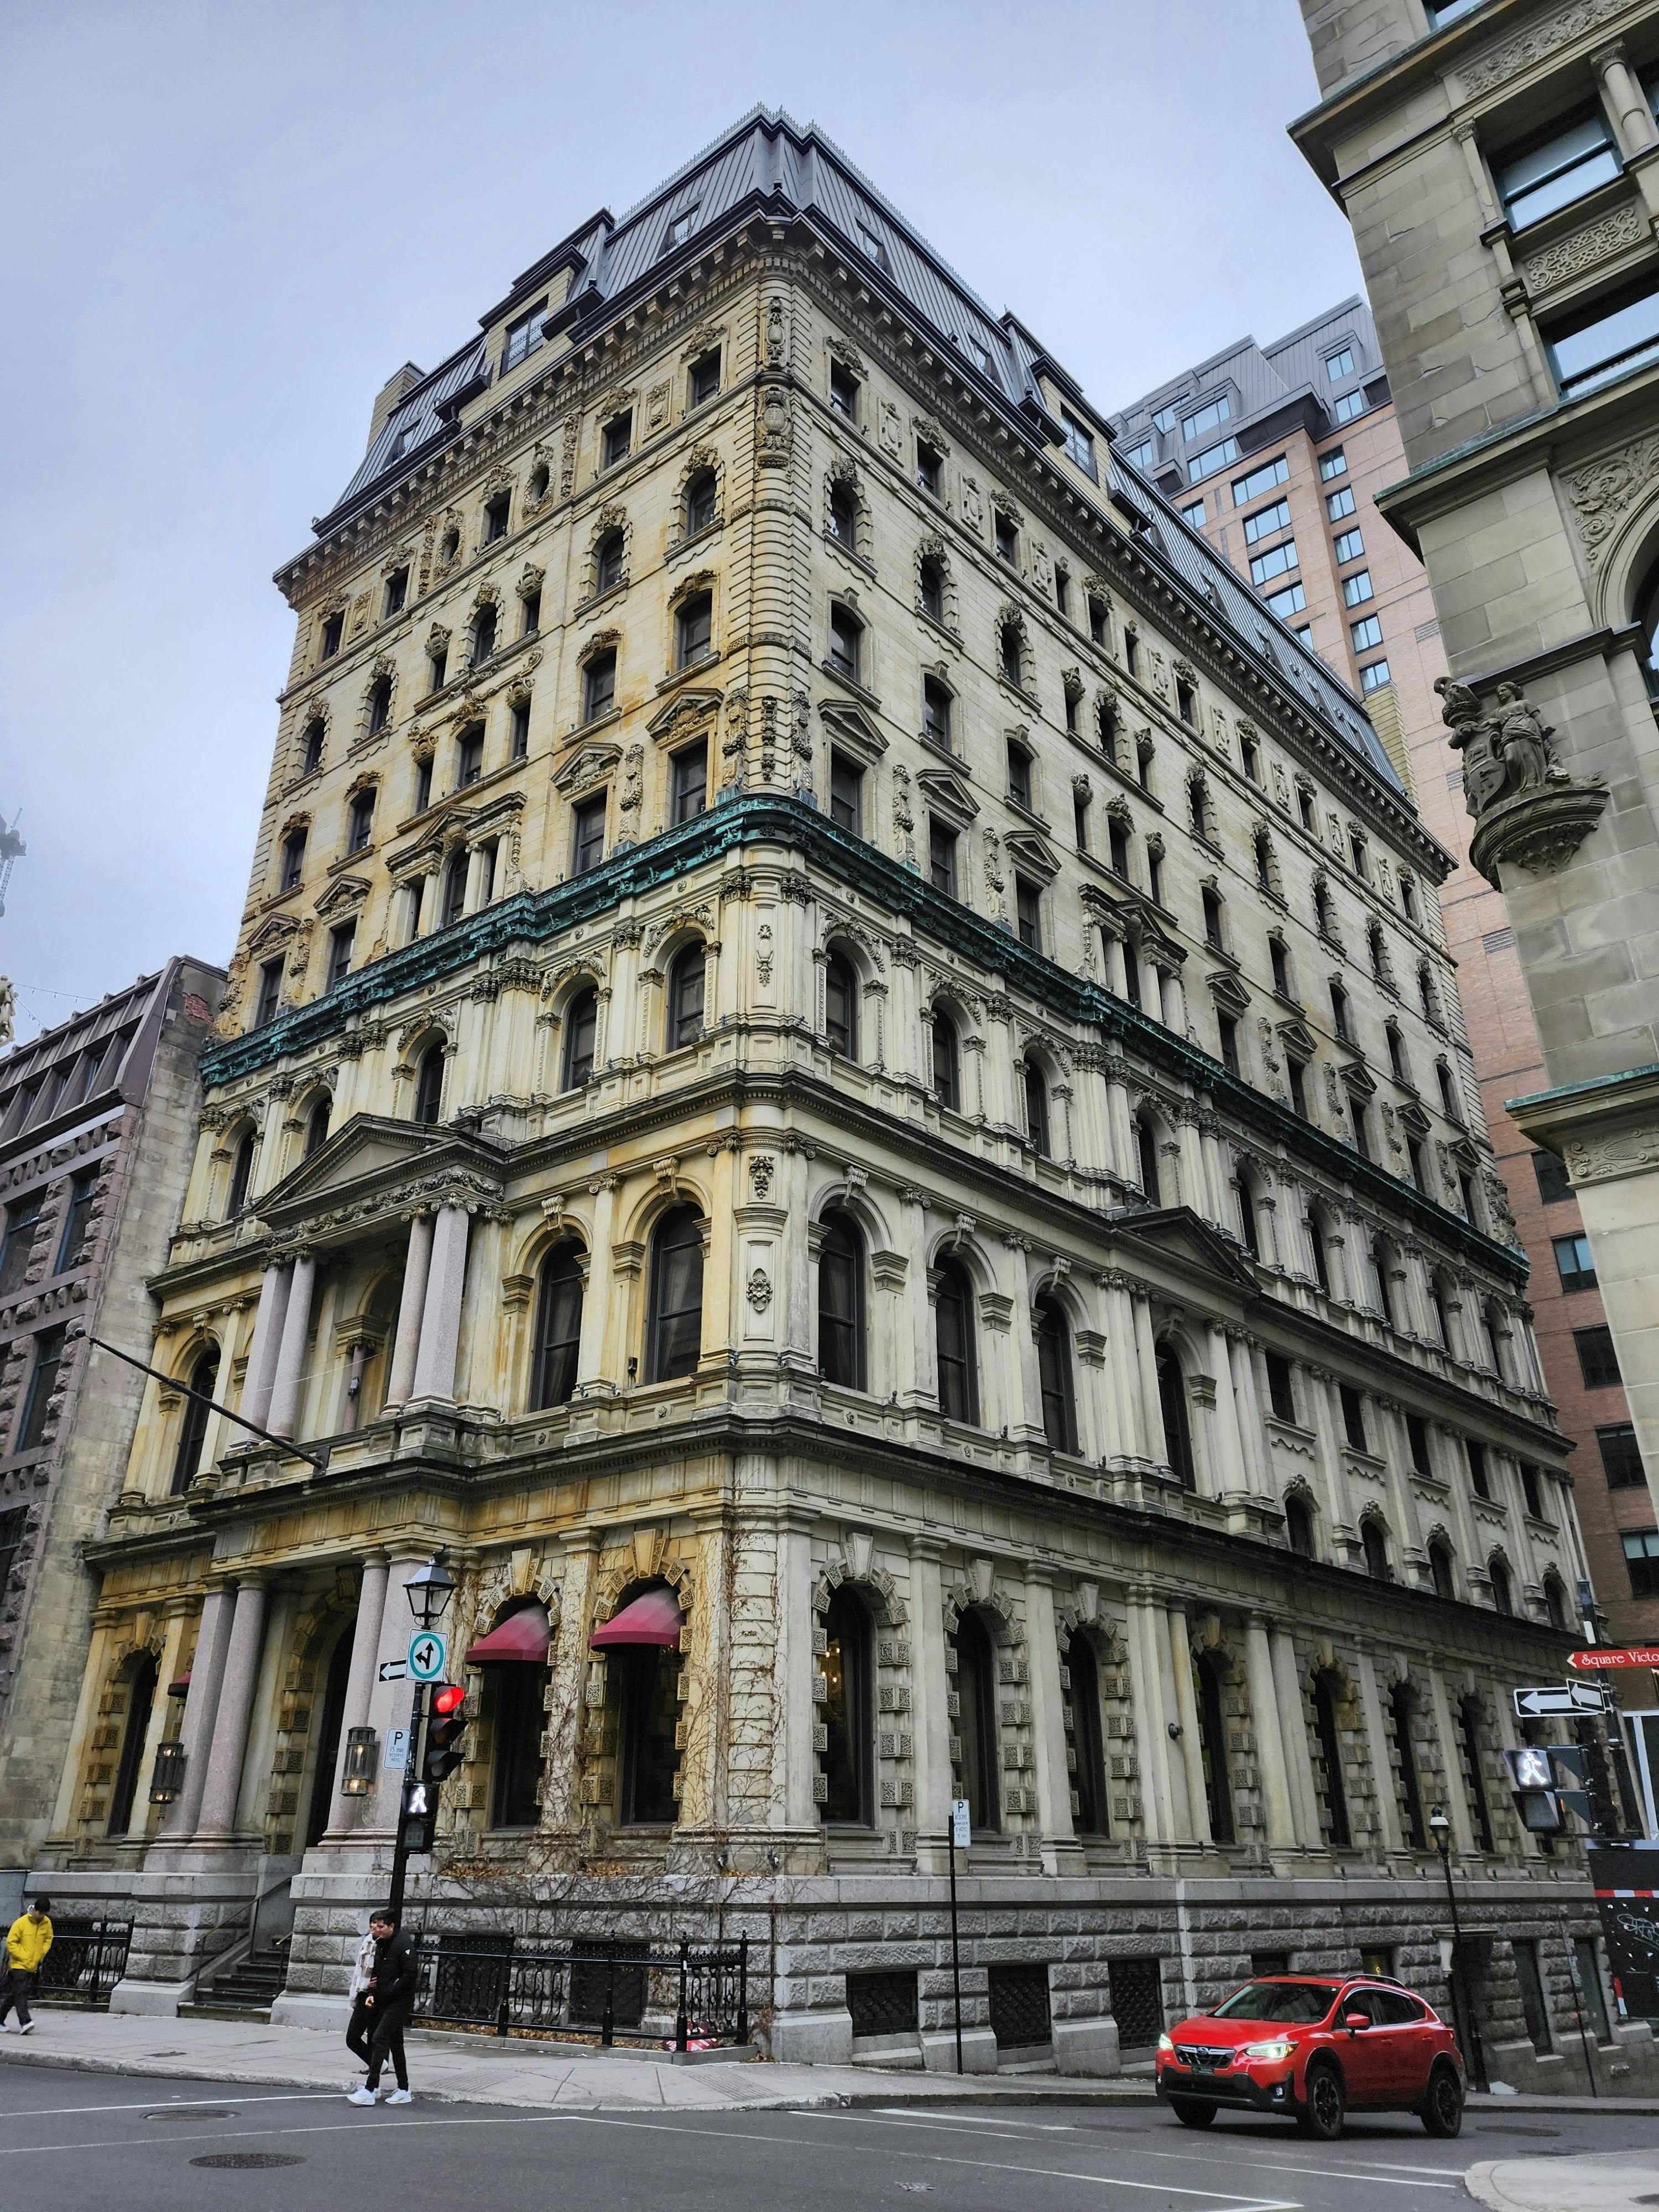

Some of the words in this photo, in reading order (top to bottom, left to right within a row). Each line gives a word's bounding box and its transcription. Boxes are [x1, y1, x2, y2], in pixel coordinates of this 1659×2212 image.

[1582, 1654, 1625, 1668] Square
[394, 1731, 403, 1745] P
[958, 1802, 964, 1813] P
